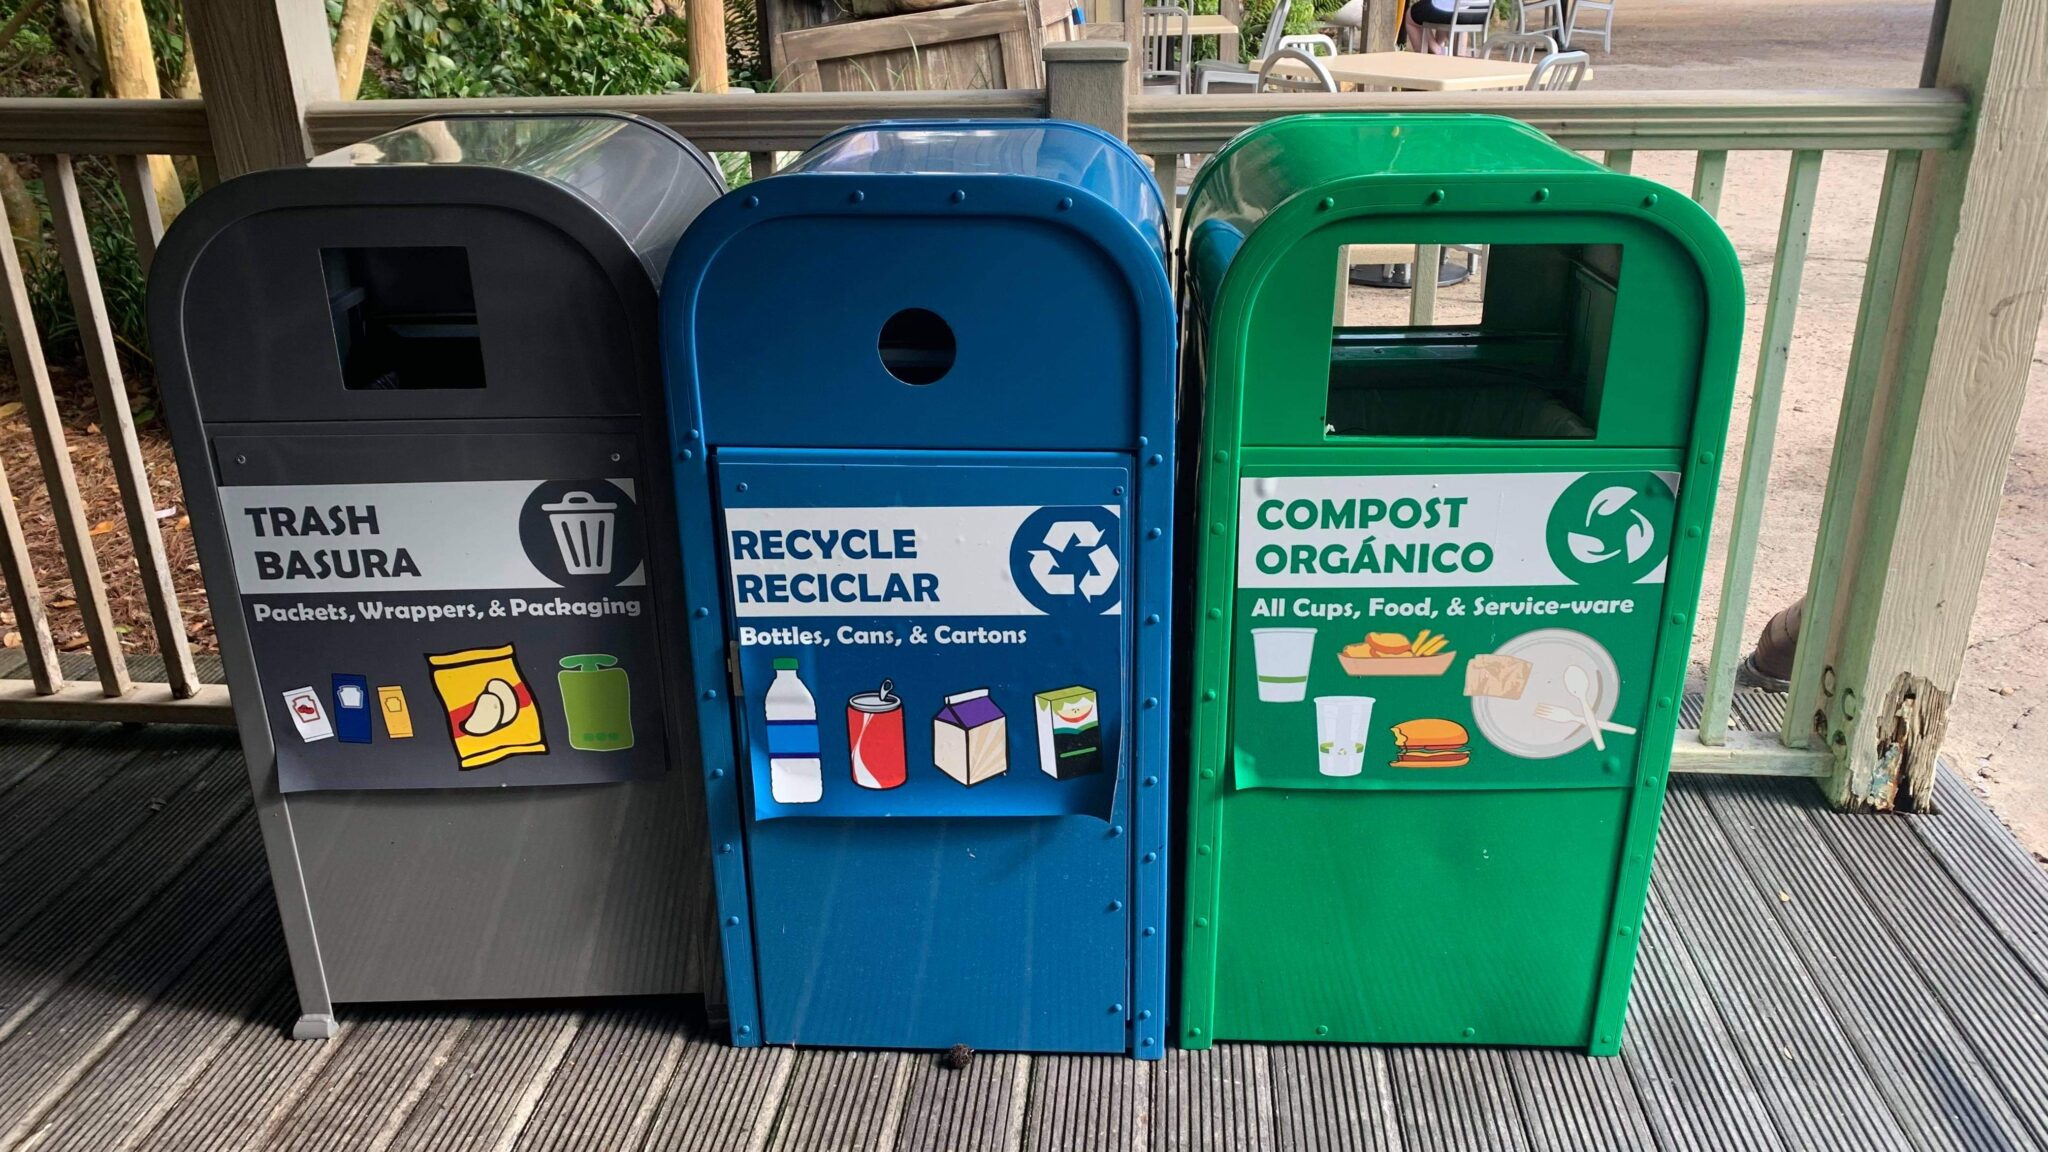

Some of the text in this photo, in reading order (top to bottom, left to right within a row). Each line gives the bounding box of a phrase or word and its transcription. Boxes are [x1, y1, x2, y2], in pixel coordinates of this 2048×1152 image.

[245, 505, 380, 537] TRASH
[1256, 497, 1468, 531] COMPOST
[731, 528, 918, 560] RECYCLE
[1255, 536, 1494, 575] ORGÁNICO
[254, 548, 422, 580] BASURA
[736, 572, 940, 603] RECICLAR
[253, 597, 641, 623] Packets, Wrappers, & Packaging
[1251, 596, 1635, 621] All Cups, Food, & Service-ware
[740, 625, 1027, 648] Bottles, Cans, & Cartons
